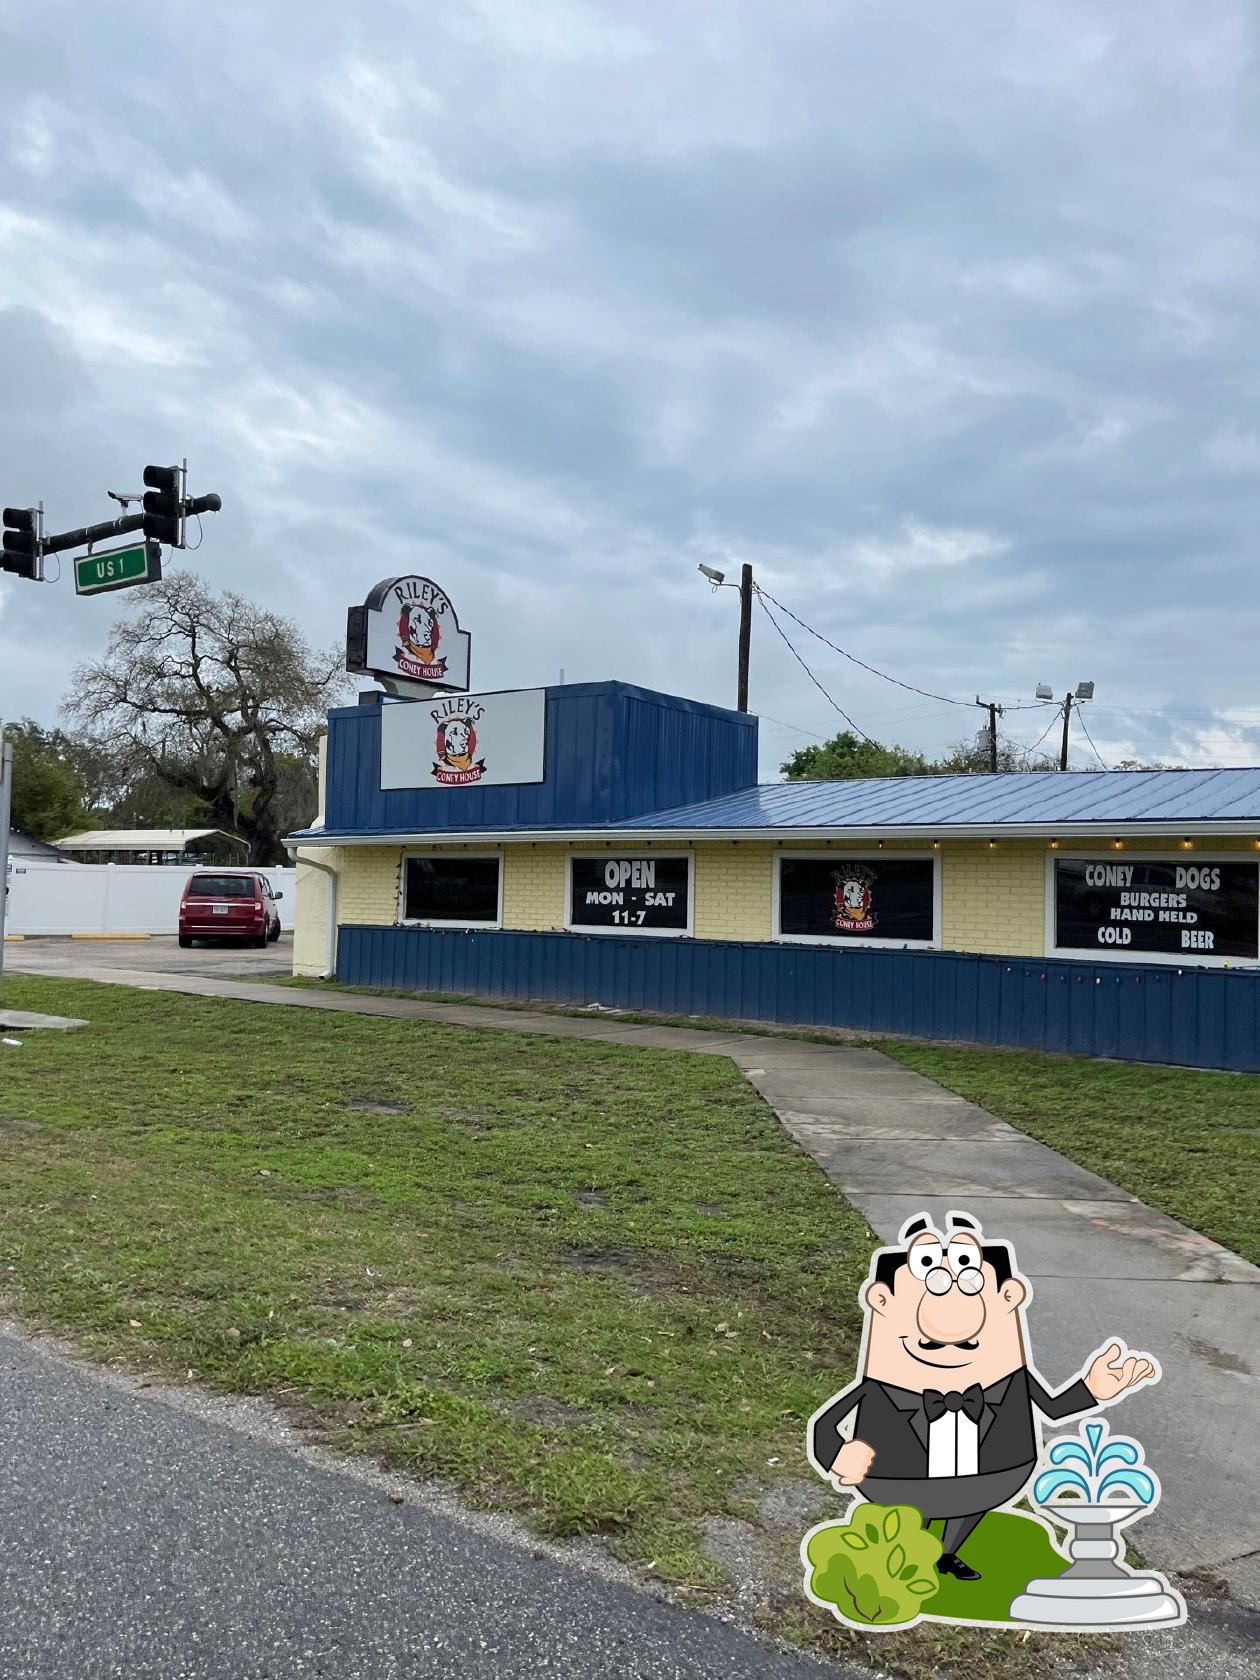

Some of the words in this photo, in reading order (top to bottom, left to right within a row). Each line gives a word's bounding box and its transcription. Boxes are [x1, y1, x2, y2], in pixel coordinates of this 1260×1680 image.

[97, 561, 115, 579] US
[119, 558, 124, 574] 1
[394, 581, 449, 615] RILEY'S
[399, 659, 422, 675] CONEY
[422, 666, 443, 678] HOUSE
[430, 697, 486, 725] RILEY'S
[437, 771, 459, 783] CONEY
[459, 769, 481, 783] HOUSE
[604, 860, 656, 889] OPEN
[1085, 865, 1135, 888] CONEY
[1175, 866, 1221, 891] DOGS
[585, 891, 624, 906] MON
[644, 892, 676, 907] SAT
[1120, 892, 1187, 908] BURGERS
[612, 909, 647, 925] 11-7
[1110, 908, 1155, 922] HAND
[1158, 910, 1198, 924] HELD
[1097, 926, 1132, 945] COLD
[1181, 929, 1215, 949] BEER
